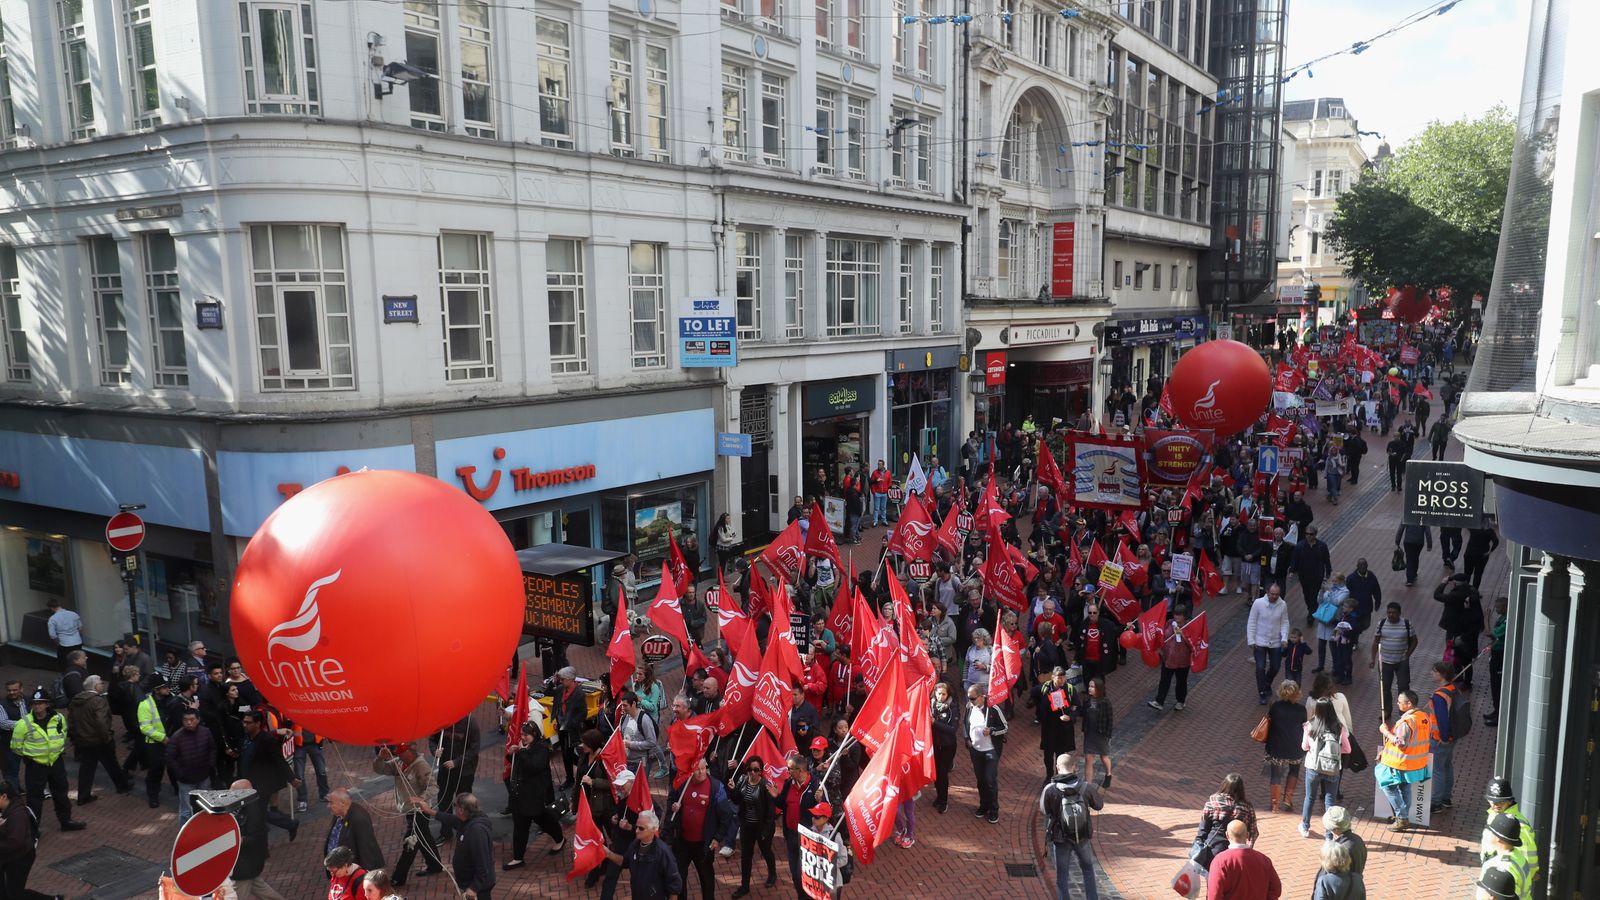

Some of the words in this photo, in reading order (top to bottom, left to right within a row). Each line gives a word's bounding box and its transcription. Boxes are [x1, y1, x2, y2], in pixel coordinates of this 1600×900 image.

[684, 320, 703, 331] TO
[708, 320, 730, 331] LET
[1027, 328, 1060, 340] PICCADILLY
[511, 463, 596, 491] Thomson
[1418, 480, 1468, 493] MOSS
[1418, 495, 1472, 509] BROS.
[957, 515, 972, 530] OUT
[1168, 510, 1182, 521] OUT
[910, 563, 930, 577] OUT
[527, 593, 586, 616] SSEMBLY/
[525, 609, 540, 626] UC
[542, 612, 580, 634] MARCH
[644, 641, 670, 655] OUT
[260, 655, 346, 688] unite
[289, 689, 354, 702] theUNION
[283, 736, 295, 759] OUT
[1416, 804, 1424, 823] WAY!
[800, 846, 834, 873] TORY
[801, 860, 834, 890] RULE
